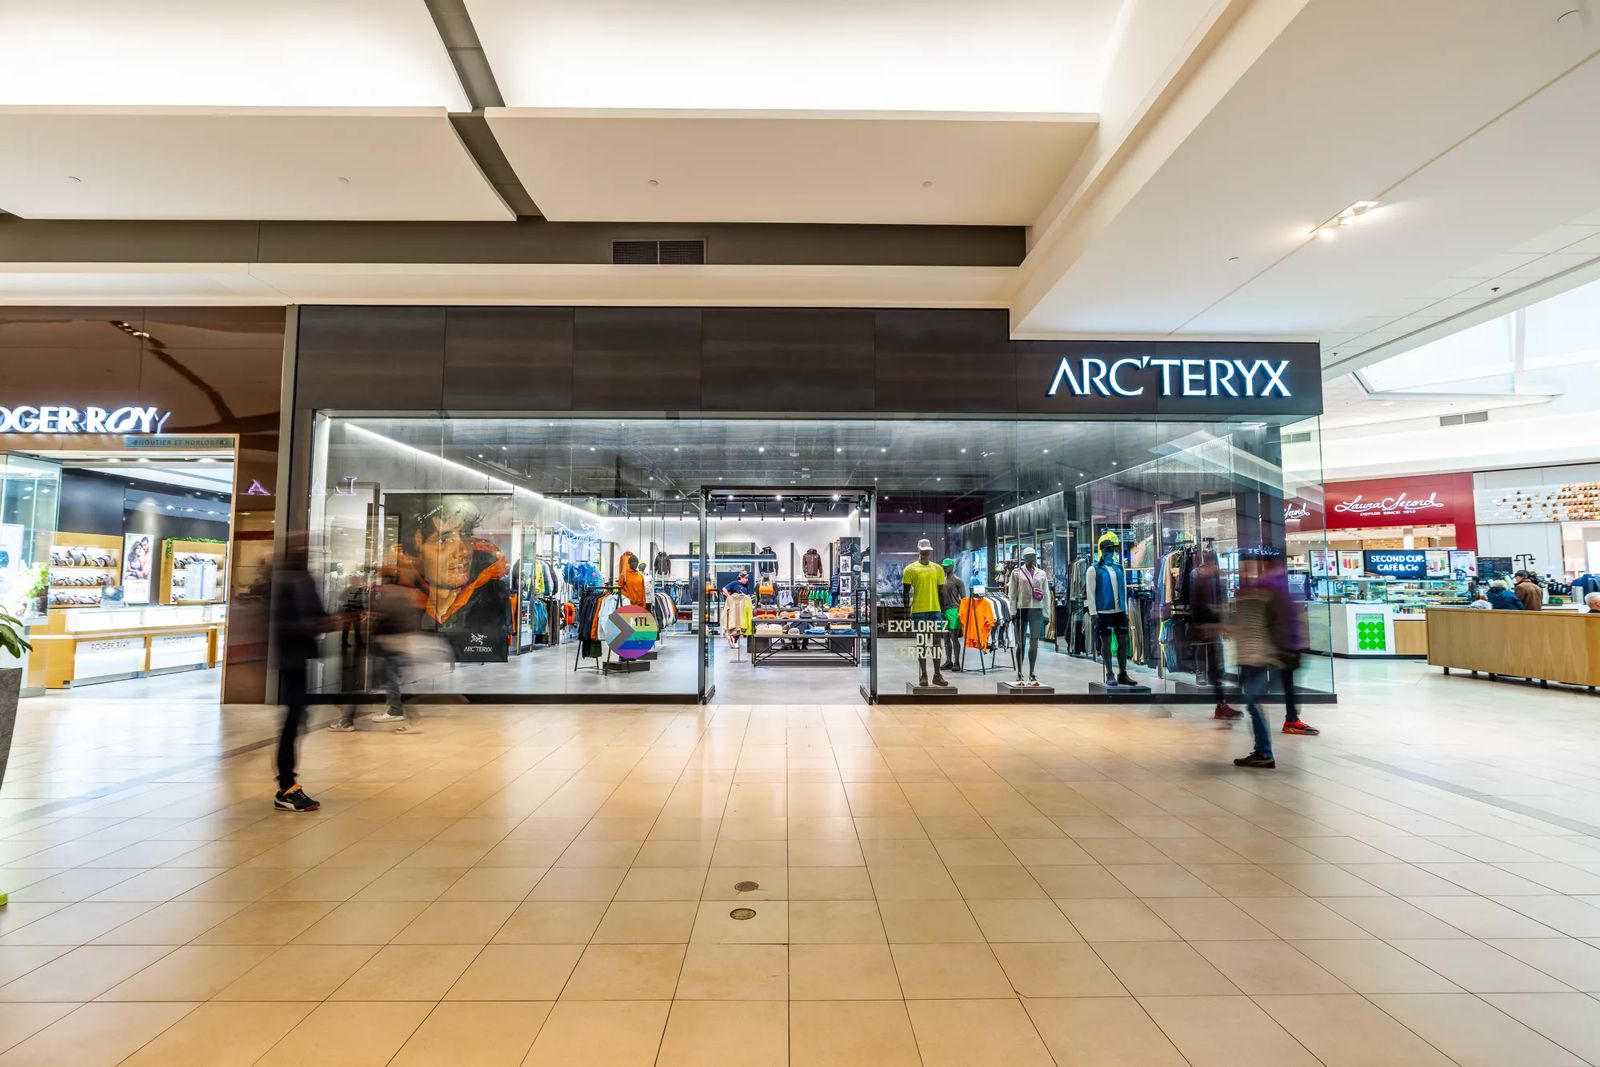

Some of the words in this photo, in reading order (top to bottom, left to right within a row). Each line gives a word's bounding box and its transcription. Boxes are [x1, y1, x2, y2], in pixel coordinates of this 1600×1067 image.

[1048, 355, 1292, 397] ARC'TERYX
[86, 406, 158, 433] ROY
[1334, 495, 1382, 512] Laura
[1371, 555, 1405, 563] SECOND
[1377, 562, 1398, 571] CAFÉ
[1405, 563, 1419, 571] Cie
[888, 620, 949, 633] EXPLOREZ
[916, 633, 934, 647] DU
